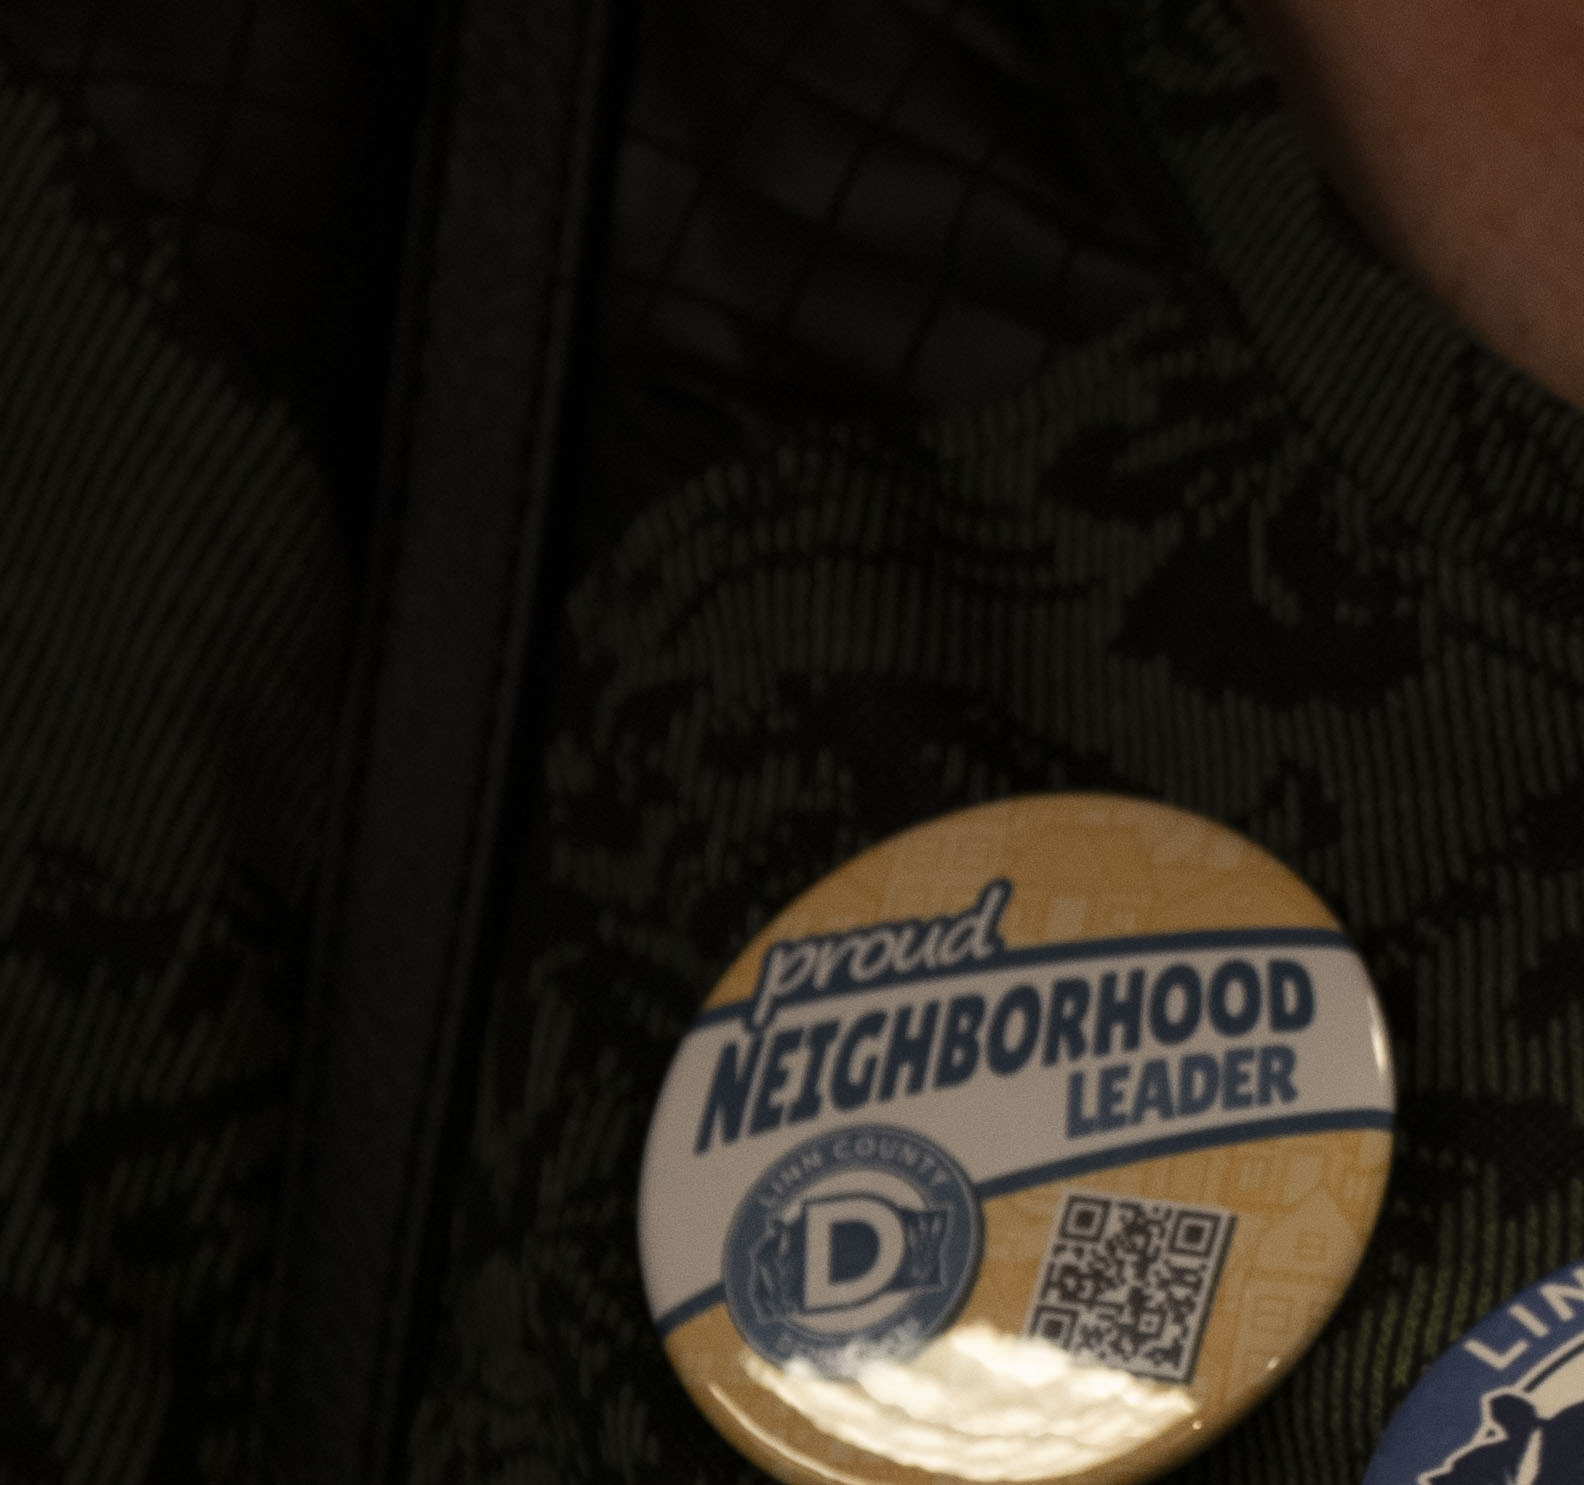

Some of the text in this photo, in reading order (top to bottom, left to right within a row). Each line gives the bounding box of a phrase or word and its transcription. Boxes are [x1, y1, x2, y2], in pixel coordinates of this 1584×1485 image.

[752, 884, 1005, 1026] proud
[694, 957, 1317, 1157] NEIGHBORHOOD
[1064, 1044, 1300, 1142] LEADER
[832, 1135, 948, 1187] COUNTY
[802, 1196, 908, 1310] D
